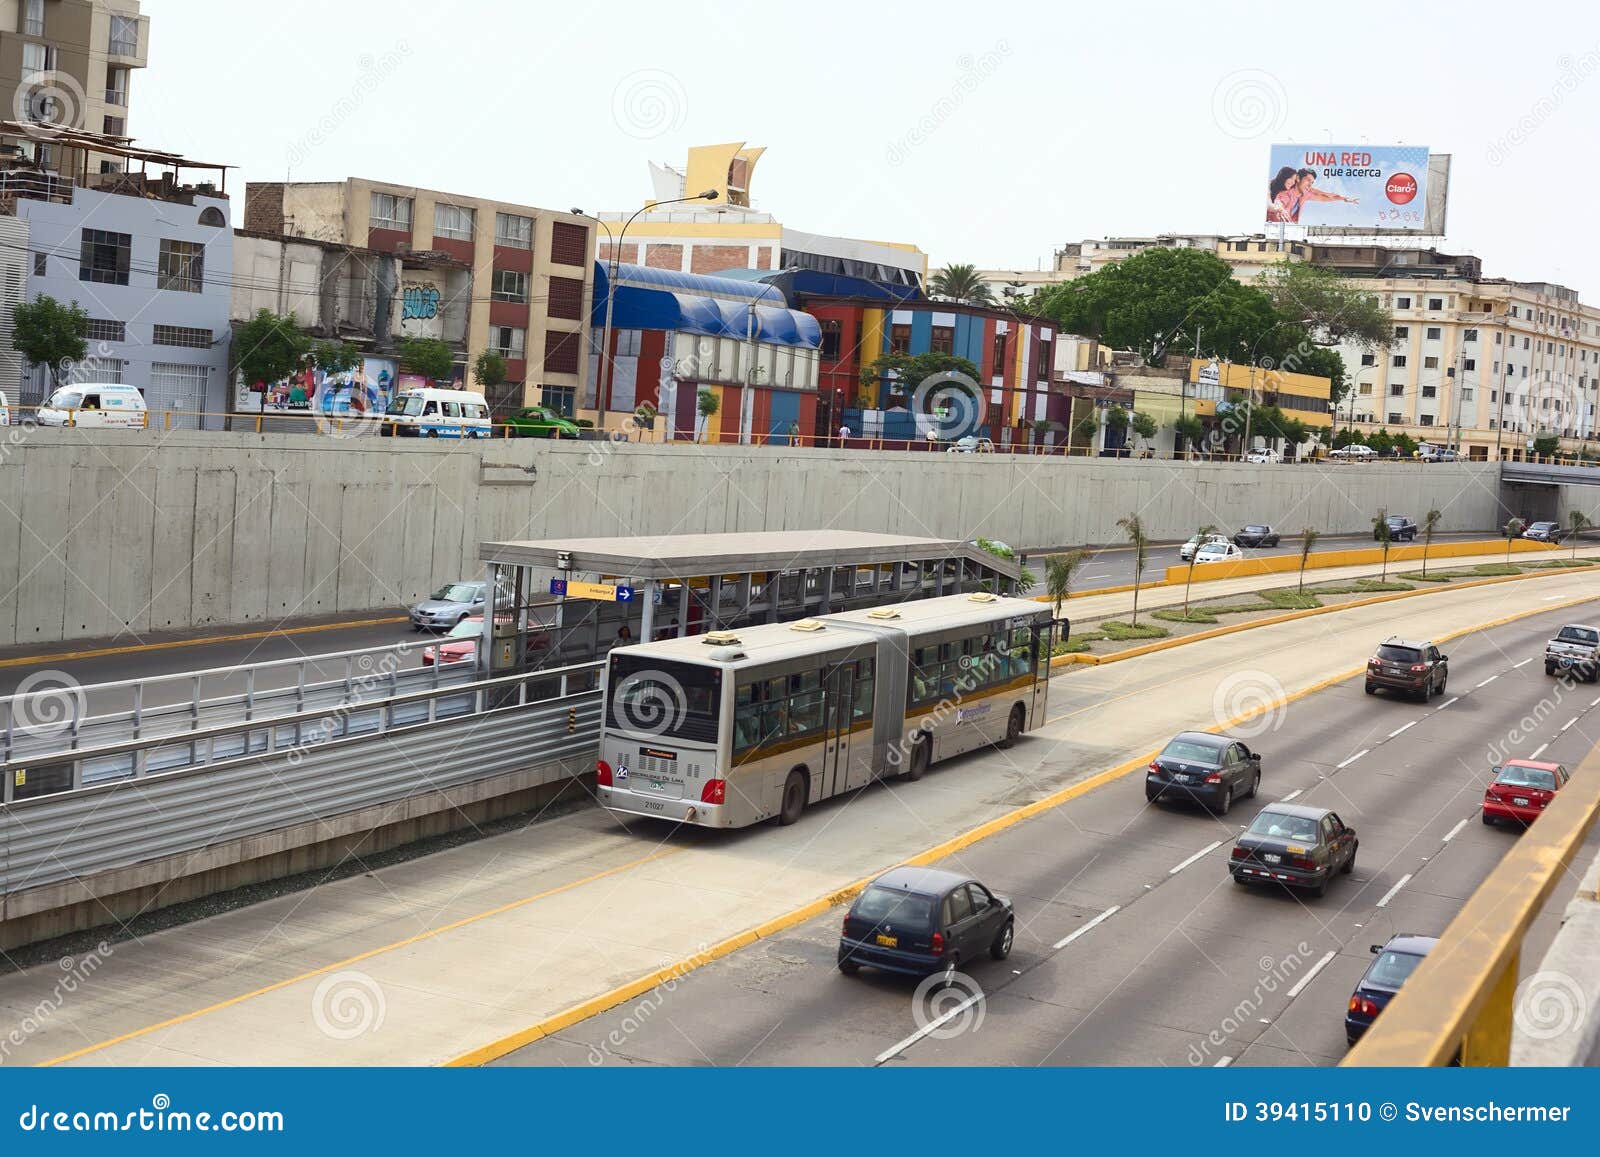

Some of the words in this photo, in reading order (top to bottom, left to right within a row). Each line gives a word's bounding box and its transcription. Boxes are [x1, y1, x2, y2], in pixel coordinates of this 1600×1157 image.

[1305, 151, 1337, 166] UNA
[1341, 152, 1372, 167] RED
[1323, 168, 1343, 179] que
[1345, 168, 1381, 178] acerca
[1387, 184, 1412, 193] Claro
[644, 800, 665, 811] 21027
